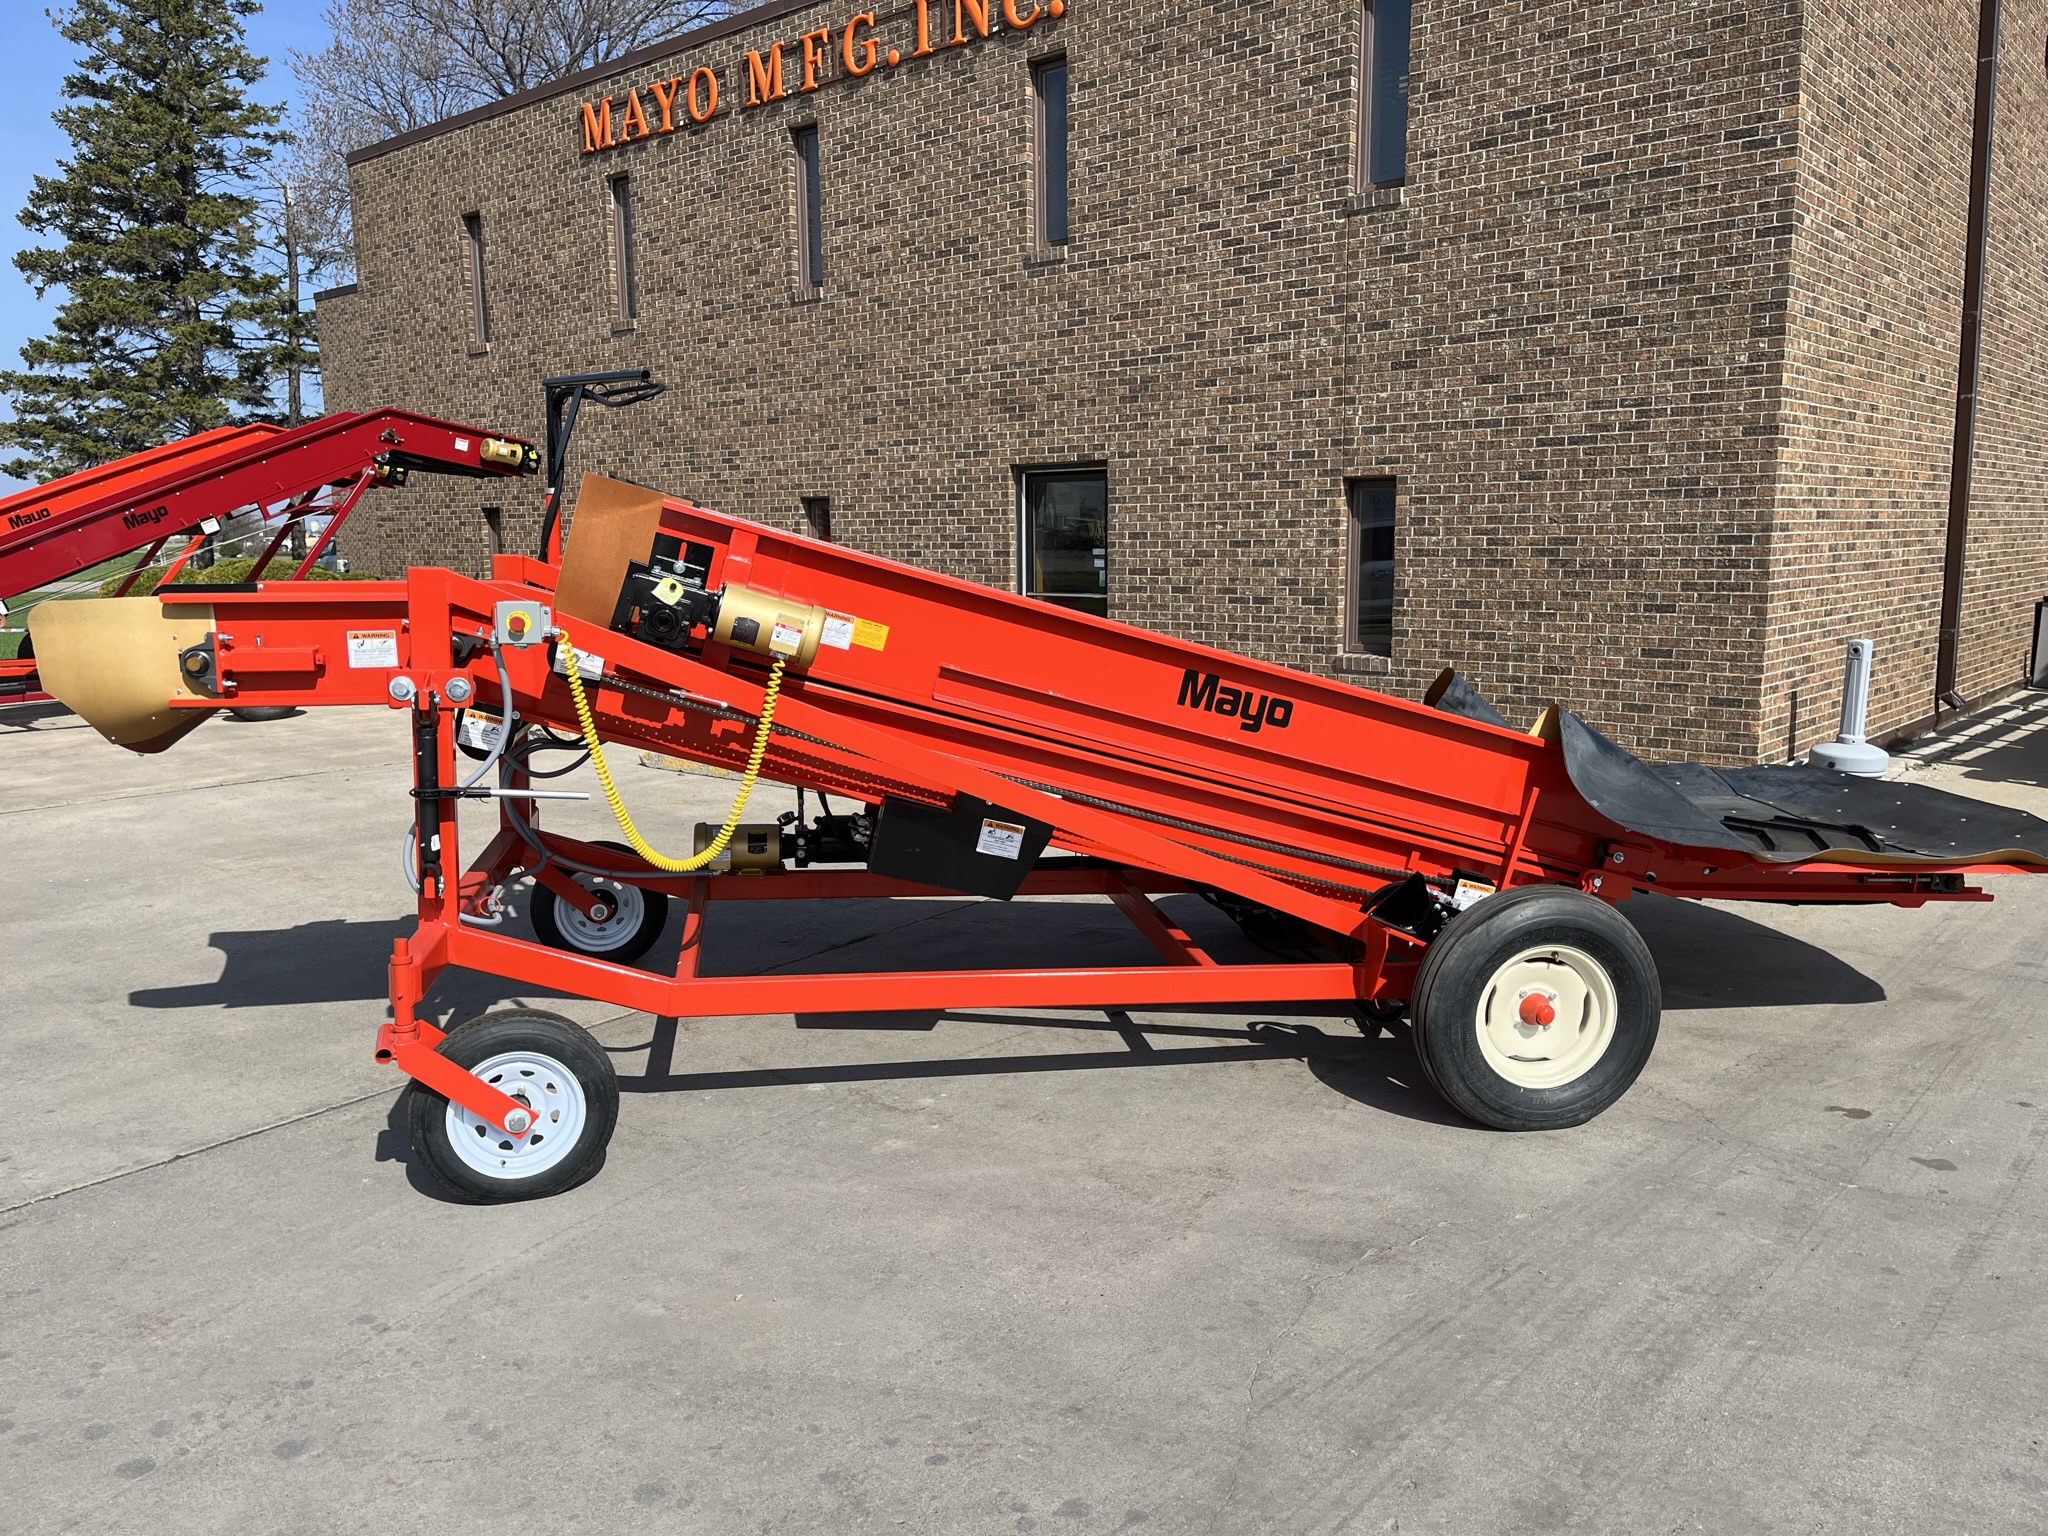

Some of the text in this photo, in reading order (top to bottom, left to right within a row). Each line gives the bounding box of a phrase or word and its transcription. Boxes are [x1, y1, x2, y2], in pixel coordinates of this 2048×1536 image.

[580, 66, 718, 154] MAYO
[123, 506, 169, 530] Mayo
[479, 715, 503, 724] WARNIN
[1177, 668, 1294, 733] Mayo
